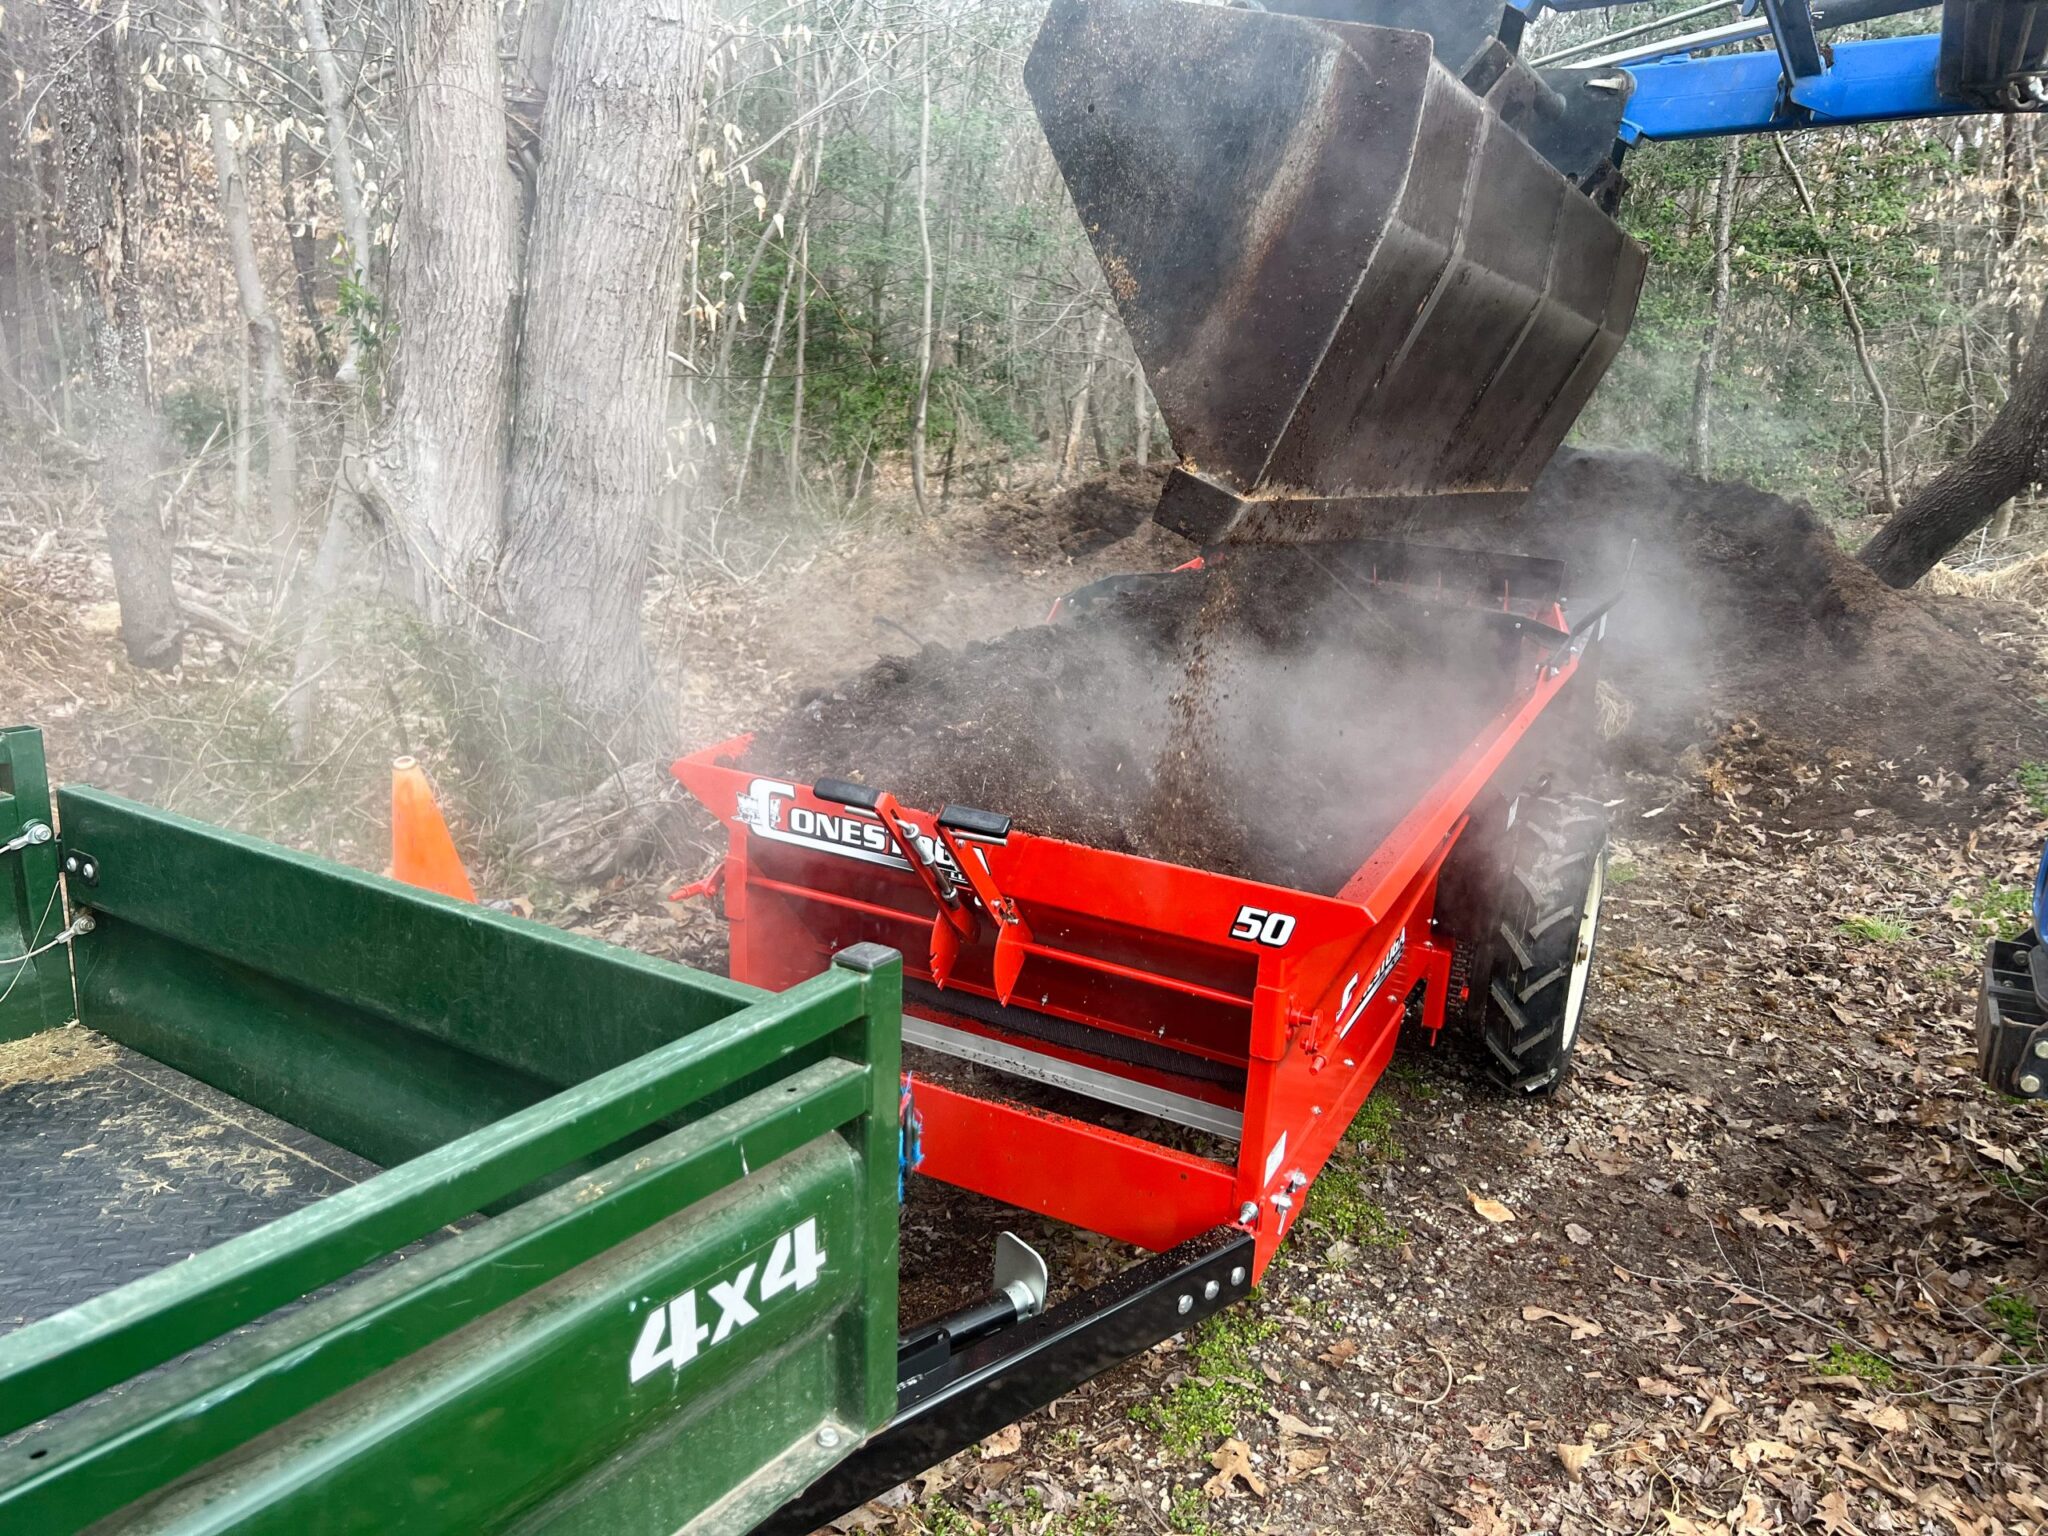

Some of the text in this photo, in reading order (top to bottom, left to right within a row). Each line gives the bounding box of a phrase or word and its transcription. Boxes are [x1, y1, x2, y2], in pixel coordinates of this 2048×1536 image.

[748, 778, 991, 877] CONESG
[1229, 905, 1296, 948] 50
[630, 1216, 827, 1384] 4x4
